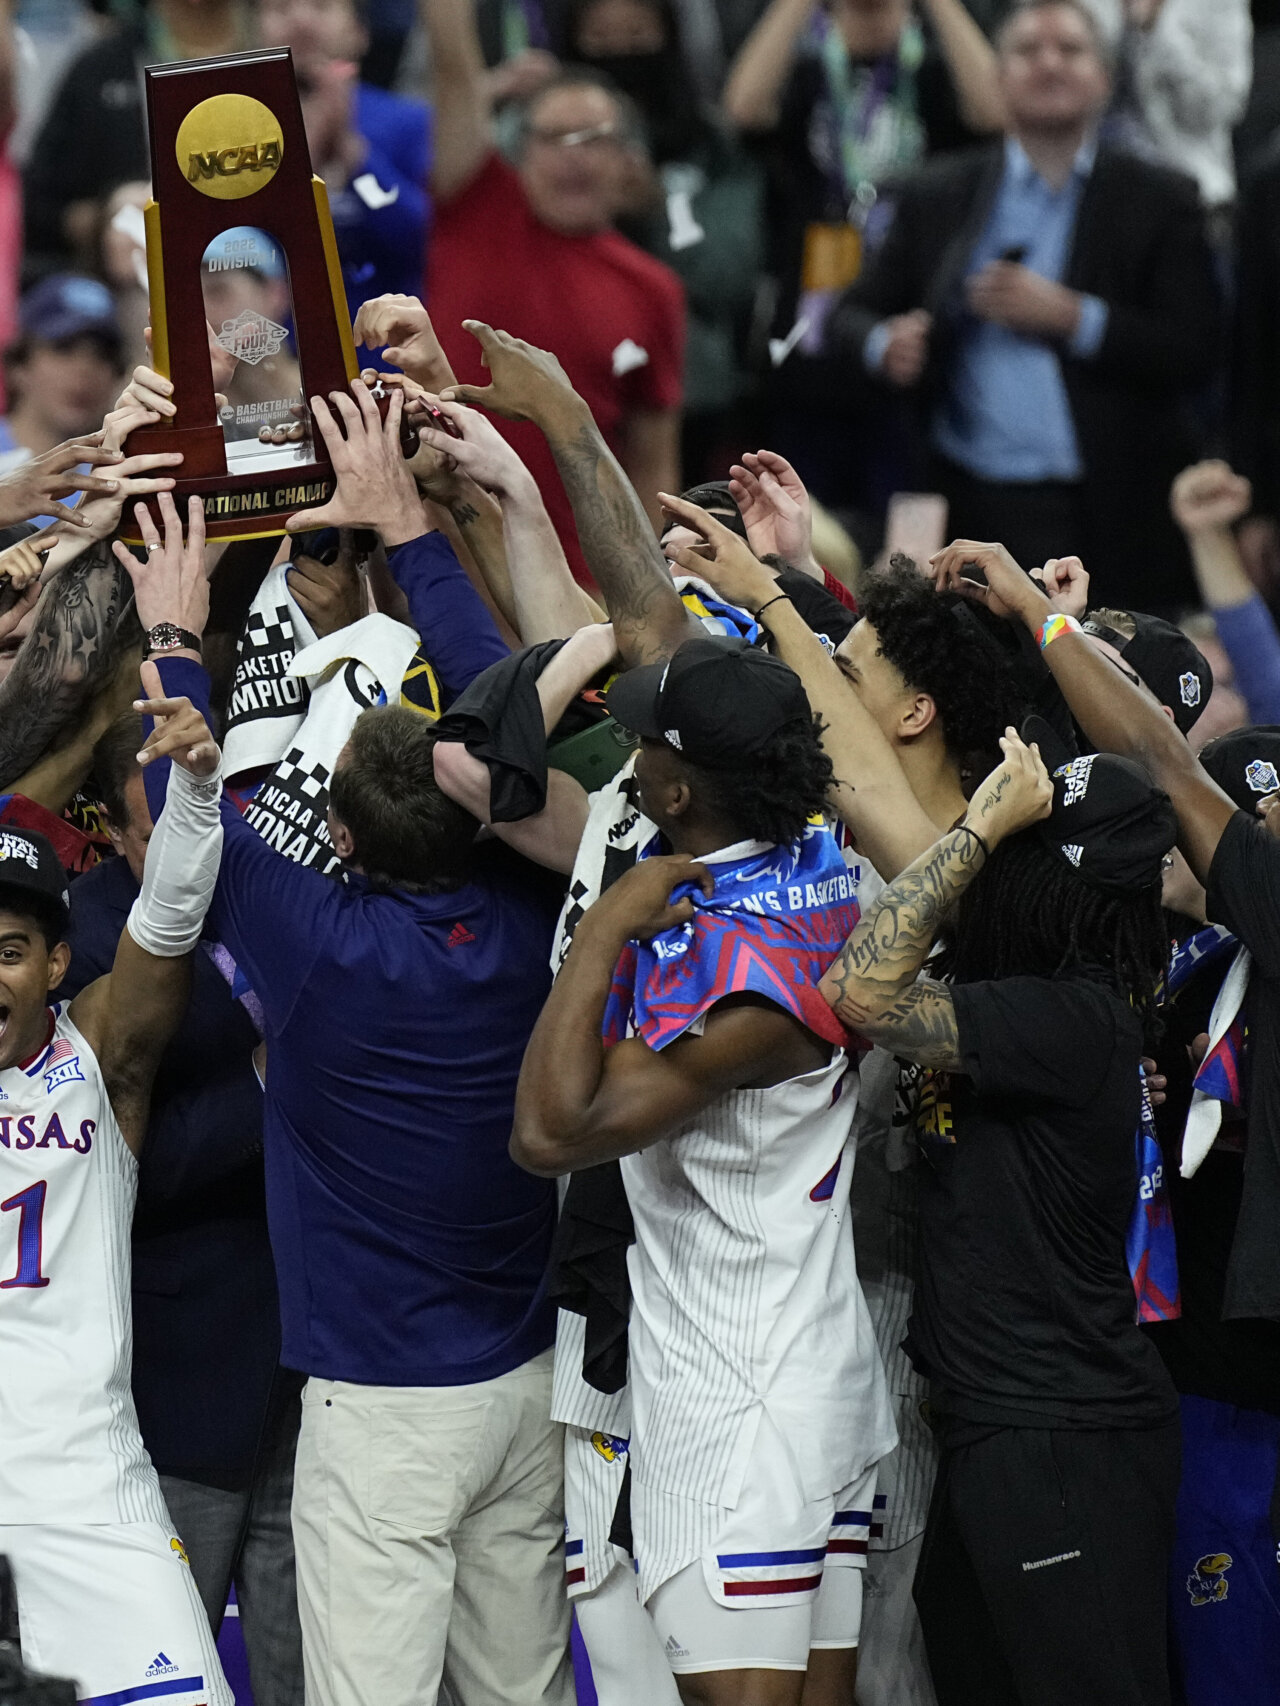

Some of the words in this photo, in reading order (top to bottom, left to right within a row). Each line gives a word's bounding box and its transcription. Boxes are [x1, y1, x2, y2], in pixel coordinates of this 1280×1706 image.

[187, 137, 283, 182] NCAA
[224, 238, 256, 253] 2022
[233, 333, 269, 352] FOUR
[236, 410, 289, 425] CHAMPIONSHIP
[202, 491, 270, 515] ATIONAL
[261, 785, 314, 829] NCAA
[608, 811, 641, 843] NCAA
[1062, 845, 1081, 868] adidas
[43, 1056, 86, 1094] XII
[145, 1663, 180, 1678] adidas
